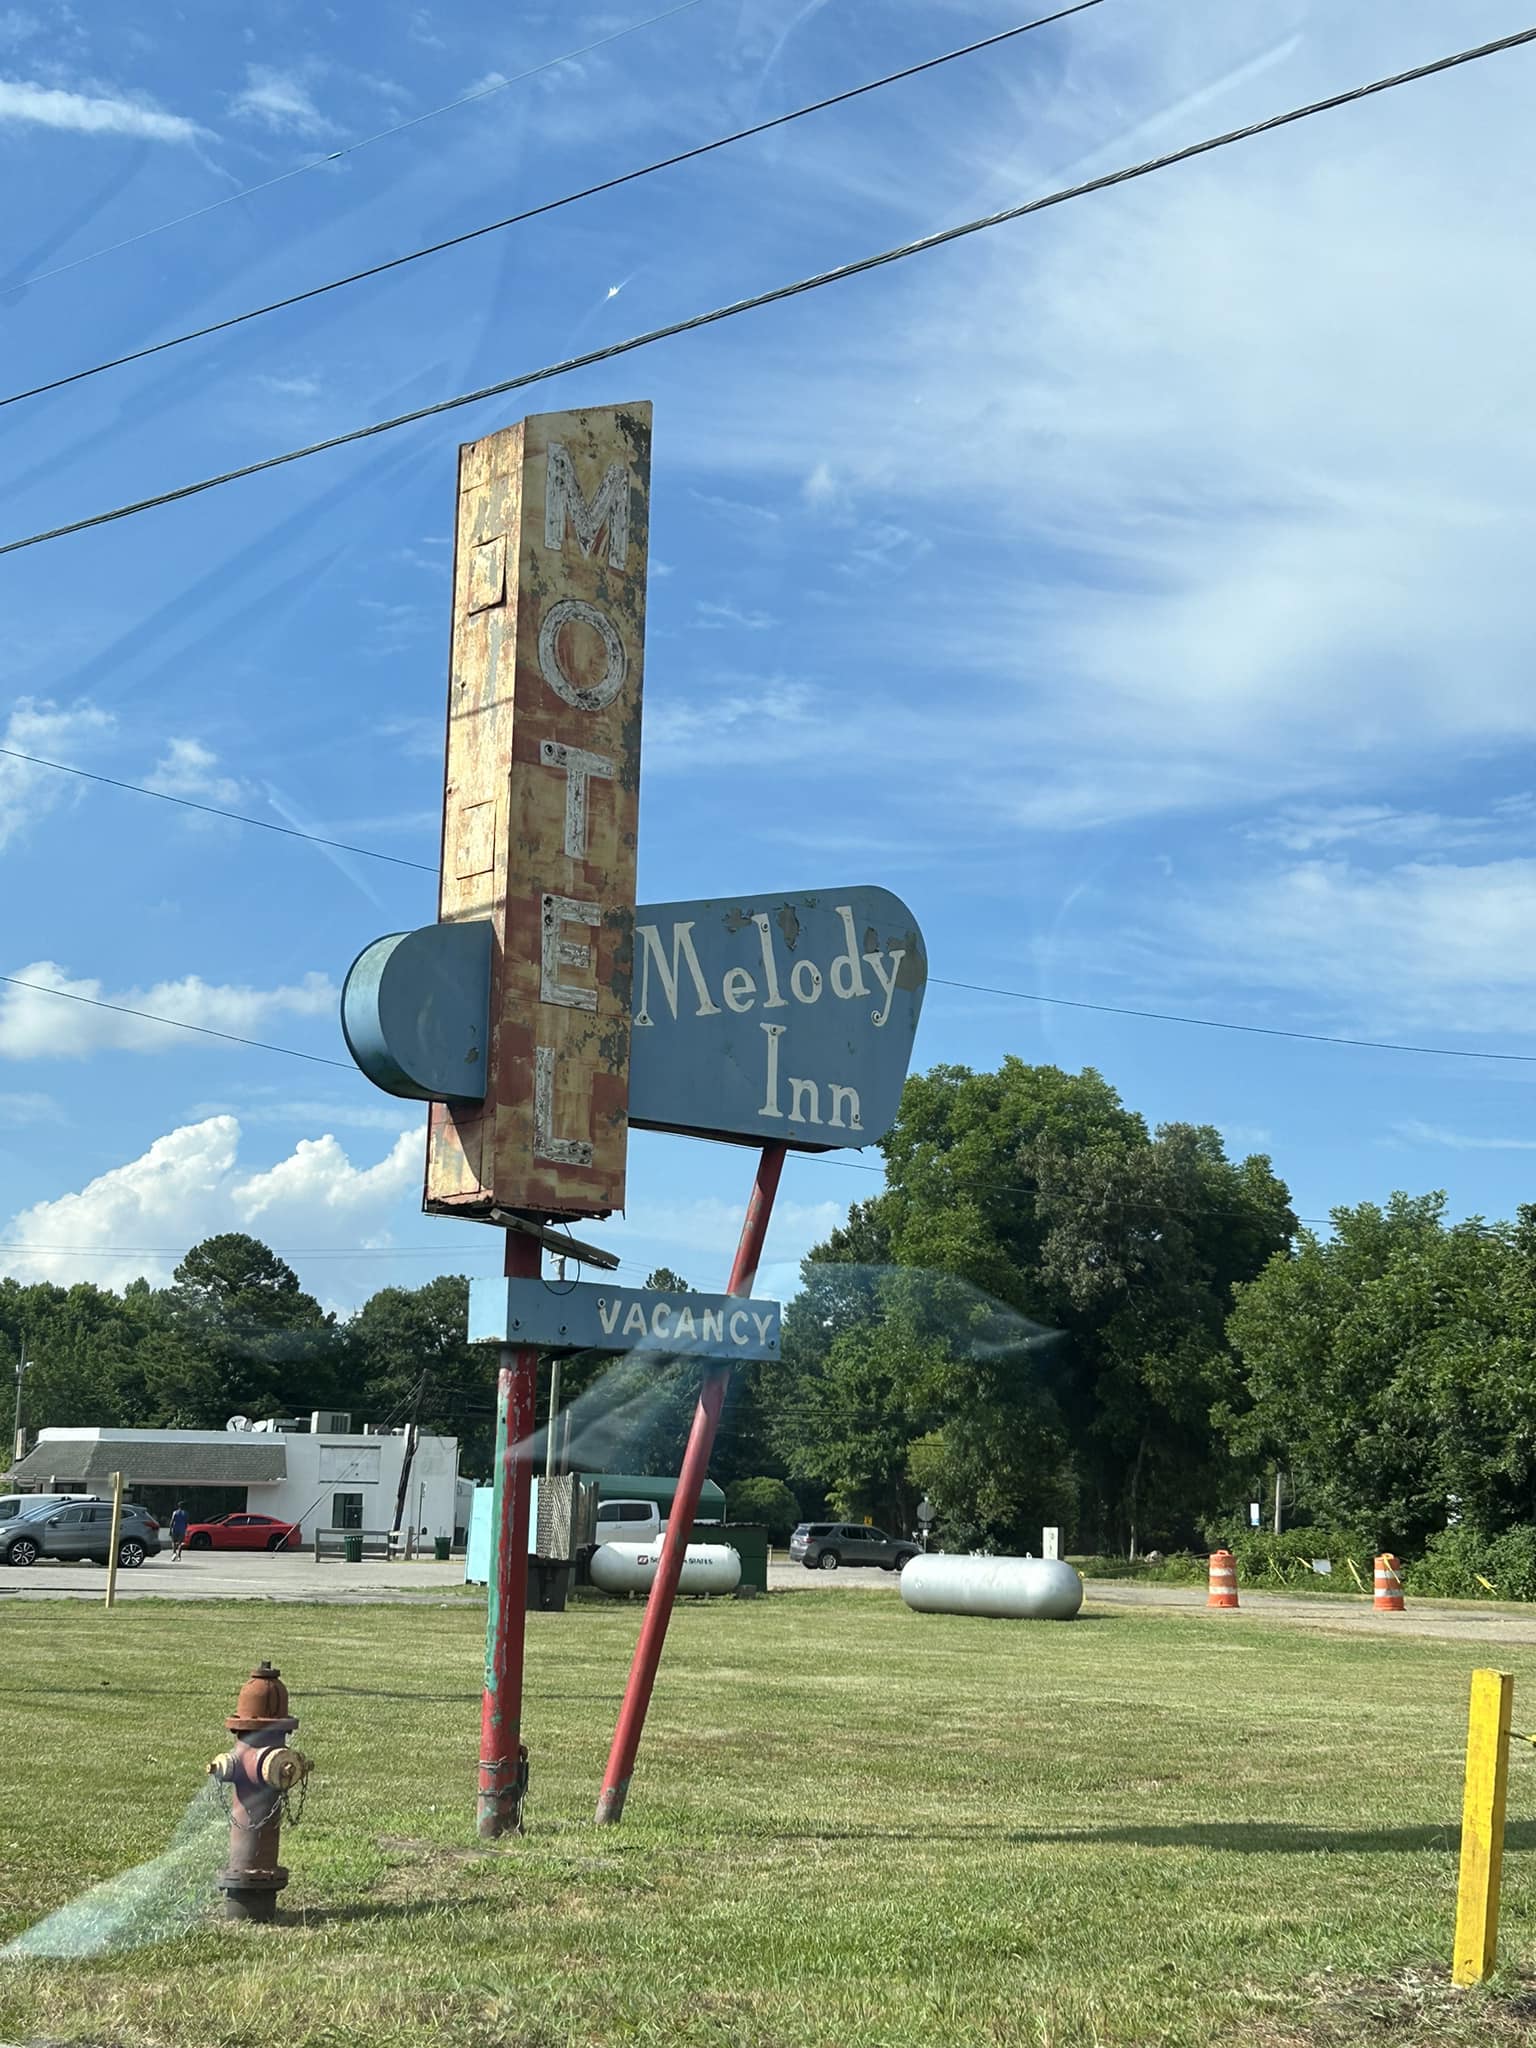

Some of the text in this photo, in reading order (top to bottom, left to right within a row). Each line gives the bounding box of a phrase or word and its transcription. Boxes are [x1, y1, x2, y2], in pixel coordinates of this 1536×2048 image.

[532, 440, 632, 1168] MOTEL
[634, 904, 906, 1027] Melody
[757, 1022, 864, 1131] Inn
[598, 1299, 774, 1346] VACANCY
